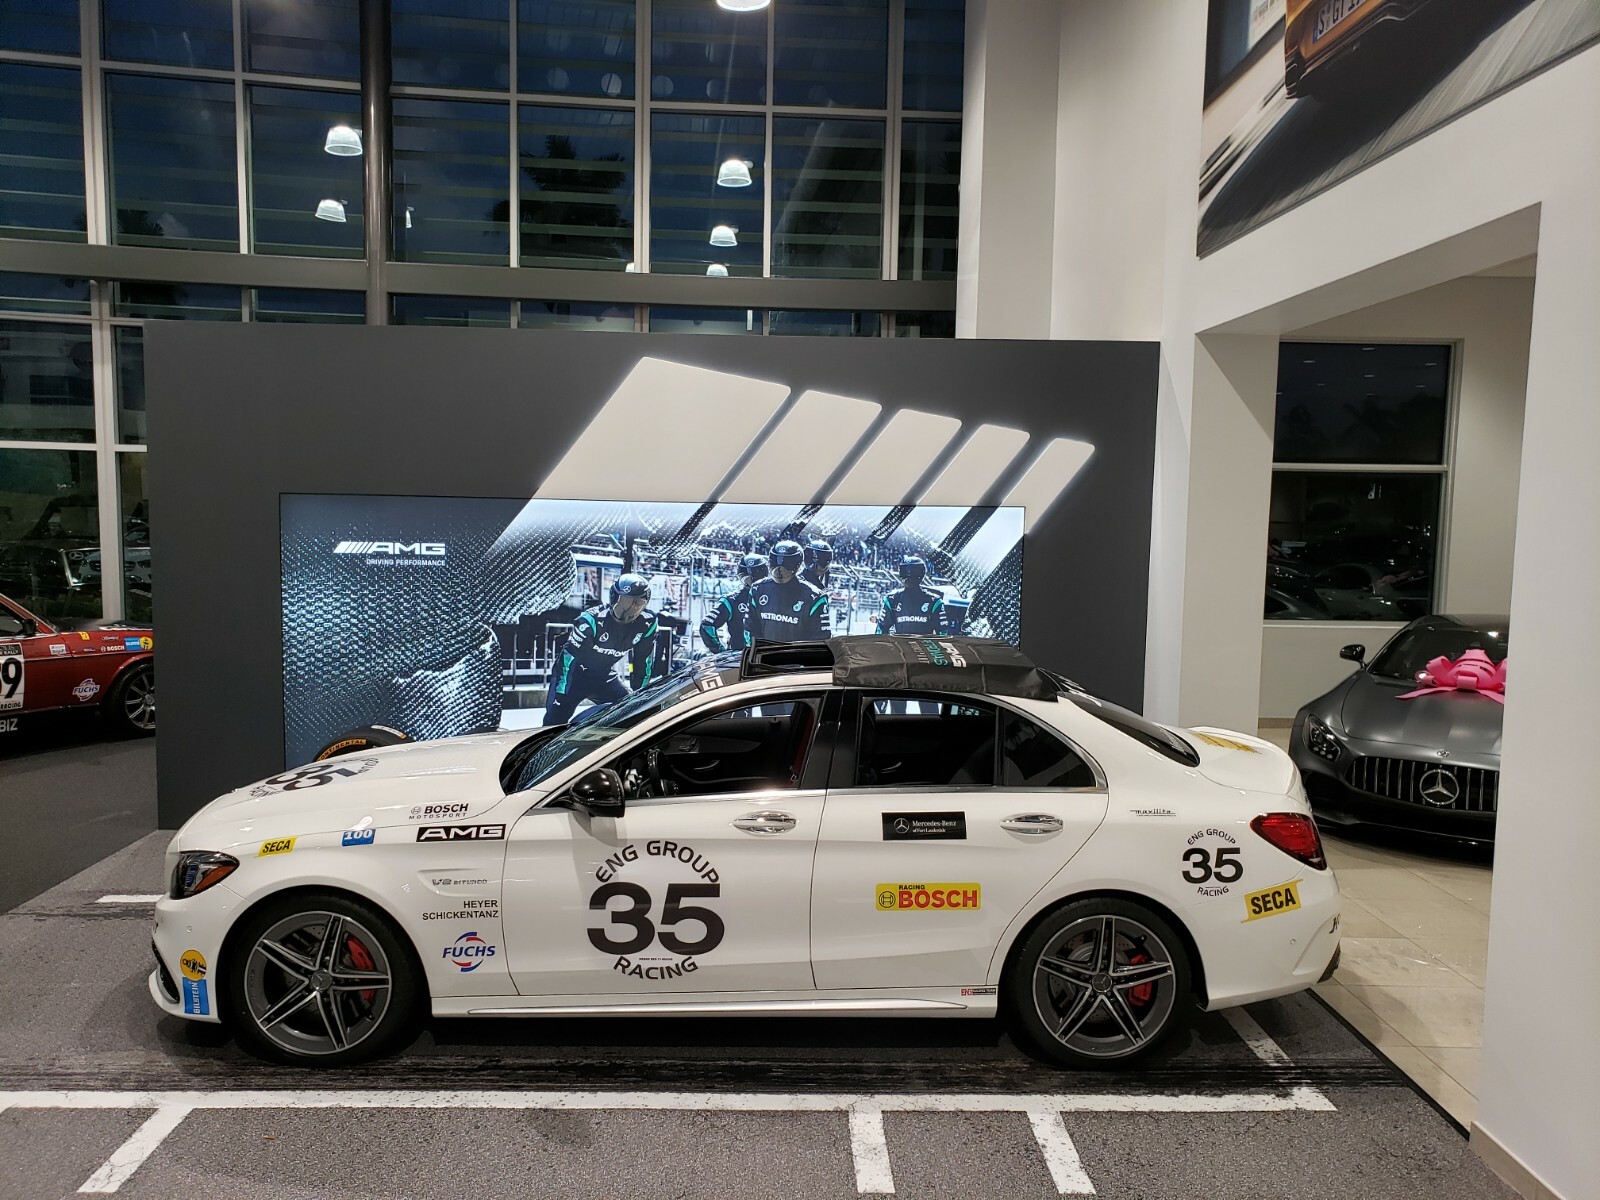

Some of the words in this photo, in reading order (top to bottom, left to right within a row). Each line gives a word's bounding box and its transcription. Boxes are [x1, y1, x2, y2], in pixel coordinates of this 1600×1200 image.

[367, 541, 445, 555] AMG
[395, 559, 446, 567] PERFORMANCE
[0, 657, 23, 699] 9
[74, 685, 100, 694] FUCHS
[424, 803, 469, 815] BOSCH
[420, 826, 503, 840] AMG
[1187, 830, 1204, 845] ENG
[1206, 828, 1236, 844] GROUP
[263, 840, 290, 853] SECA
[596, 845, 639, 883] ENG
[646, 840, 720, 883] GROUP
[1182, 847, 1243, 884] 35
[1197, 885, 1230, 897] RACING
[463, 900, 498, 909] HEYER
[898, 890, 978, 908] BOSCH
[1250, 887, 1297, 915] SECA
[422, 910, 499, 920] SCHICKENTANZ
[587, 881, 725, 956] 35
[442, 945, 496, 959] FUCHS
[613, 955, 699, 980] RACING
[191, 981, 201, 1014] BILSTEIN
